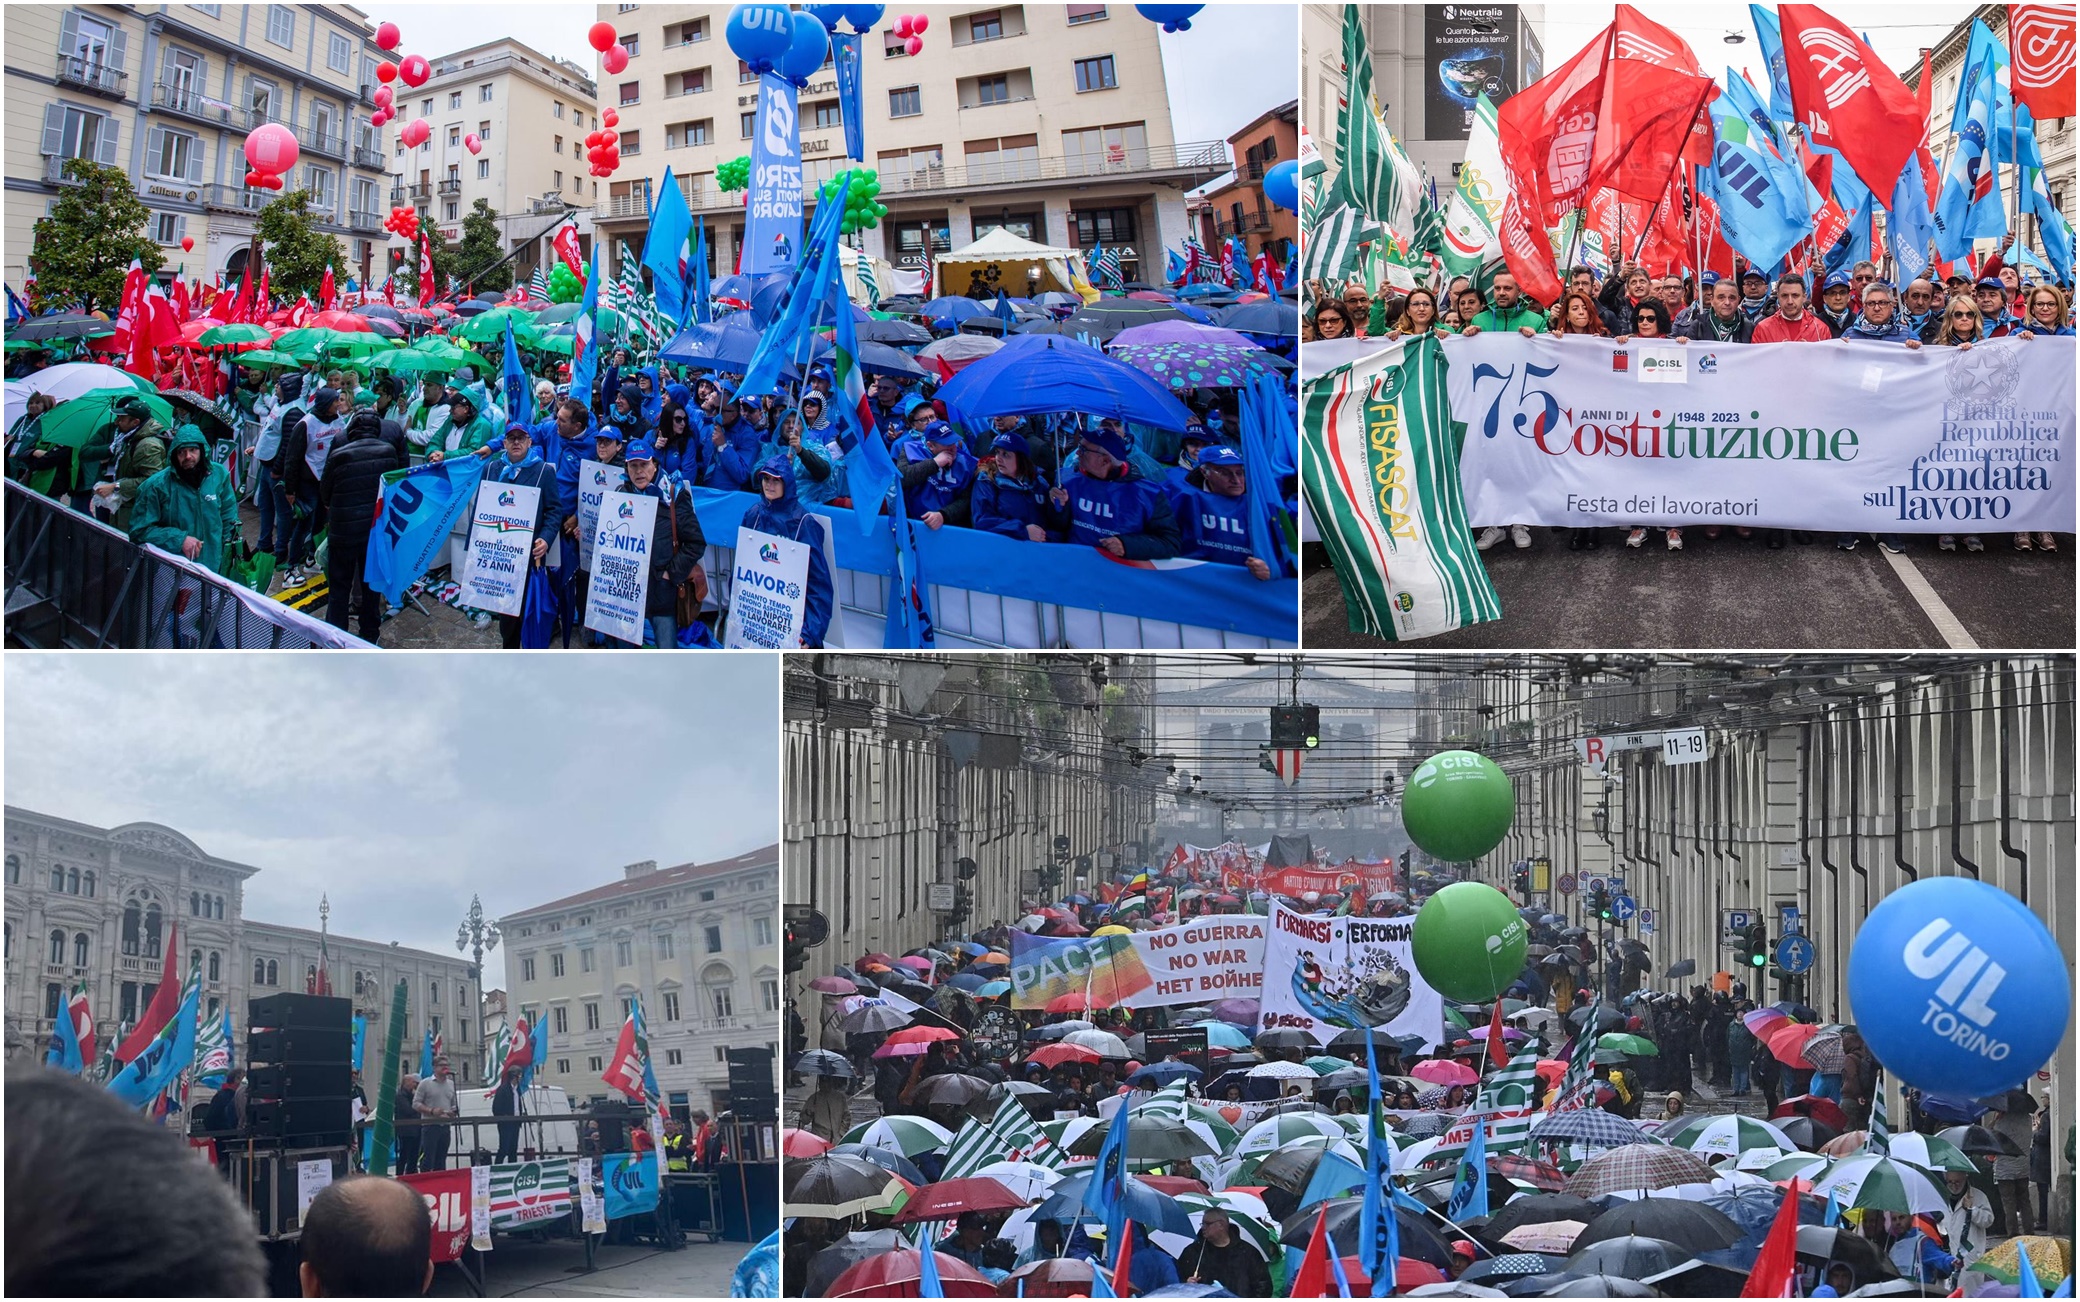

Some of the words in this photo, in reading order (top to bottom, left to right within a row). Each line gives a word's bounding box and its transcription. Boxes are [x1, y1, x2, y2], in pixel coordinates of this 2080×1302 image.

[1459, 8, 1503, 16] Neutralia
[742, 8, 788, 35] UIL
[258, 132, 282, 142] CGIL
[1716, 140, 1771, 209] UIL
[149, 186, 182, 199] Allianz
[1902, 243, 1925, 266] ZERO
[1657, 359, 1682, 368] CISL
[1472, 362, 1560, 439] 75
[1580, 410, 1612, 421] ANNI
[1615, 410, 1628, 421] DI
[1677, 412, 1705, 422] 1948
[1711, 412, 1740, 422] 2023
[2020, 407, 2029, 420] è
[2032, 410, 2058, 420] una
[939, 425, 950, 433] UIL
[1533, 408, 1859, 462] Costituzione
[1940, 420, 2060, 447] Repubblica
[1219, 447, 1234, 456] UIL
[1928, 442, 2061, 462] democratica
[1368, 403, 1418, 542] FISASCAT
[1908, 453, 2052, 492] fondata
[1078, 497, 1114, 519] UIL
[1566, 493, 1619, 513] Festa
[1624, 494, 1656, 514] dei
[1661, 495, 1758, 516] lavoratori
[1863, 485, 1895, 507] sul
[1896, 485, 2011, 520] lavoro
[479, 513, 530, 527] COSTITUZIONE
[623, 507, 634, 516] UIL
[1202, 514, 1245, 535] UIL
[474, 540, 525, 555] COSTITUZIONE
[479, 548, 493, 556] COME
[766, 550, 779, 561] UIL
[476, 558, 488, 568] 75
[489, 561, 516, 574] ANNI
[600, 560, 638, 574] DOBBIAMO
[601, 553, 622, 563] QUANTO
[622, 557, 640, 567] TEMPO
[600, 567, 636, 583] ASPETTARE
[469, 580, 502, 591] COSTITUZIONE
[485, 590, 505, 598] ANZIANI
[616, 579, 641, 594] VISITA
[608, 586, 640, 603] ESAME?
[741, 589, 768, 604] QUANTO
[769, 599, 791, 612] TEMPO
[619, 606, 639, 617] PAGANO
[738, 595, 762, 608] DEVONO
[762, 604, 793, 619] ASPETTARE
[742, 603, 762, 616] NOSTRI
[763, 611, 792, 627] NIPOTI
[598, 608, 615, 618] PREZZO
[623, 616, 635, 624] ALTO
[736, 608, 747, 618] PER
[747, 611, 792, 635] LAVORARE?
[742, 630, 781, 649] FUGGIRE?
[743, 625, 774, 642] OBBLIGATI
[767, 627, 785, 640] SONO
[1627, 735, 1643, 745] FINE
[1667, 735, 1703, 755] 11-19
[1586, 737, 1605, 764] R
[1441, 755, 1484, 769] CISL
[1609, 881, 1624, 895] Park
[1734, 914, 1744, 927] P
[1782, 915, 1799, 934] Park
[1149, 933, 1178, 950] NO
[1183, 924, 1264, 944] GUERRA
[1501, 920, 1520, 940] CISL
[1009, 937, 1112, 1000] PACE
[1168, 953, 1198, 971] NO
[1203, 949, 1248, 966] WAR
[1902, 917, 2007, 1028] UIL
[1156, 977, 1194, 995] НЕТ
[1200, 969, 1263, 991] ВОЙНЕ
[1921, 998, 2011, 1061] TORINO
[516, 1174, 537, 1187] CISL
[622, 1170, 646, 1191] UIL
[516, 1204, 553, 1221] TRIESTE
